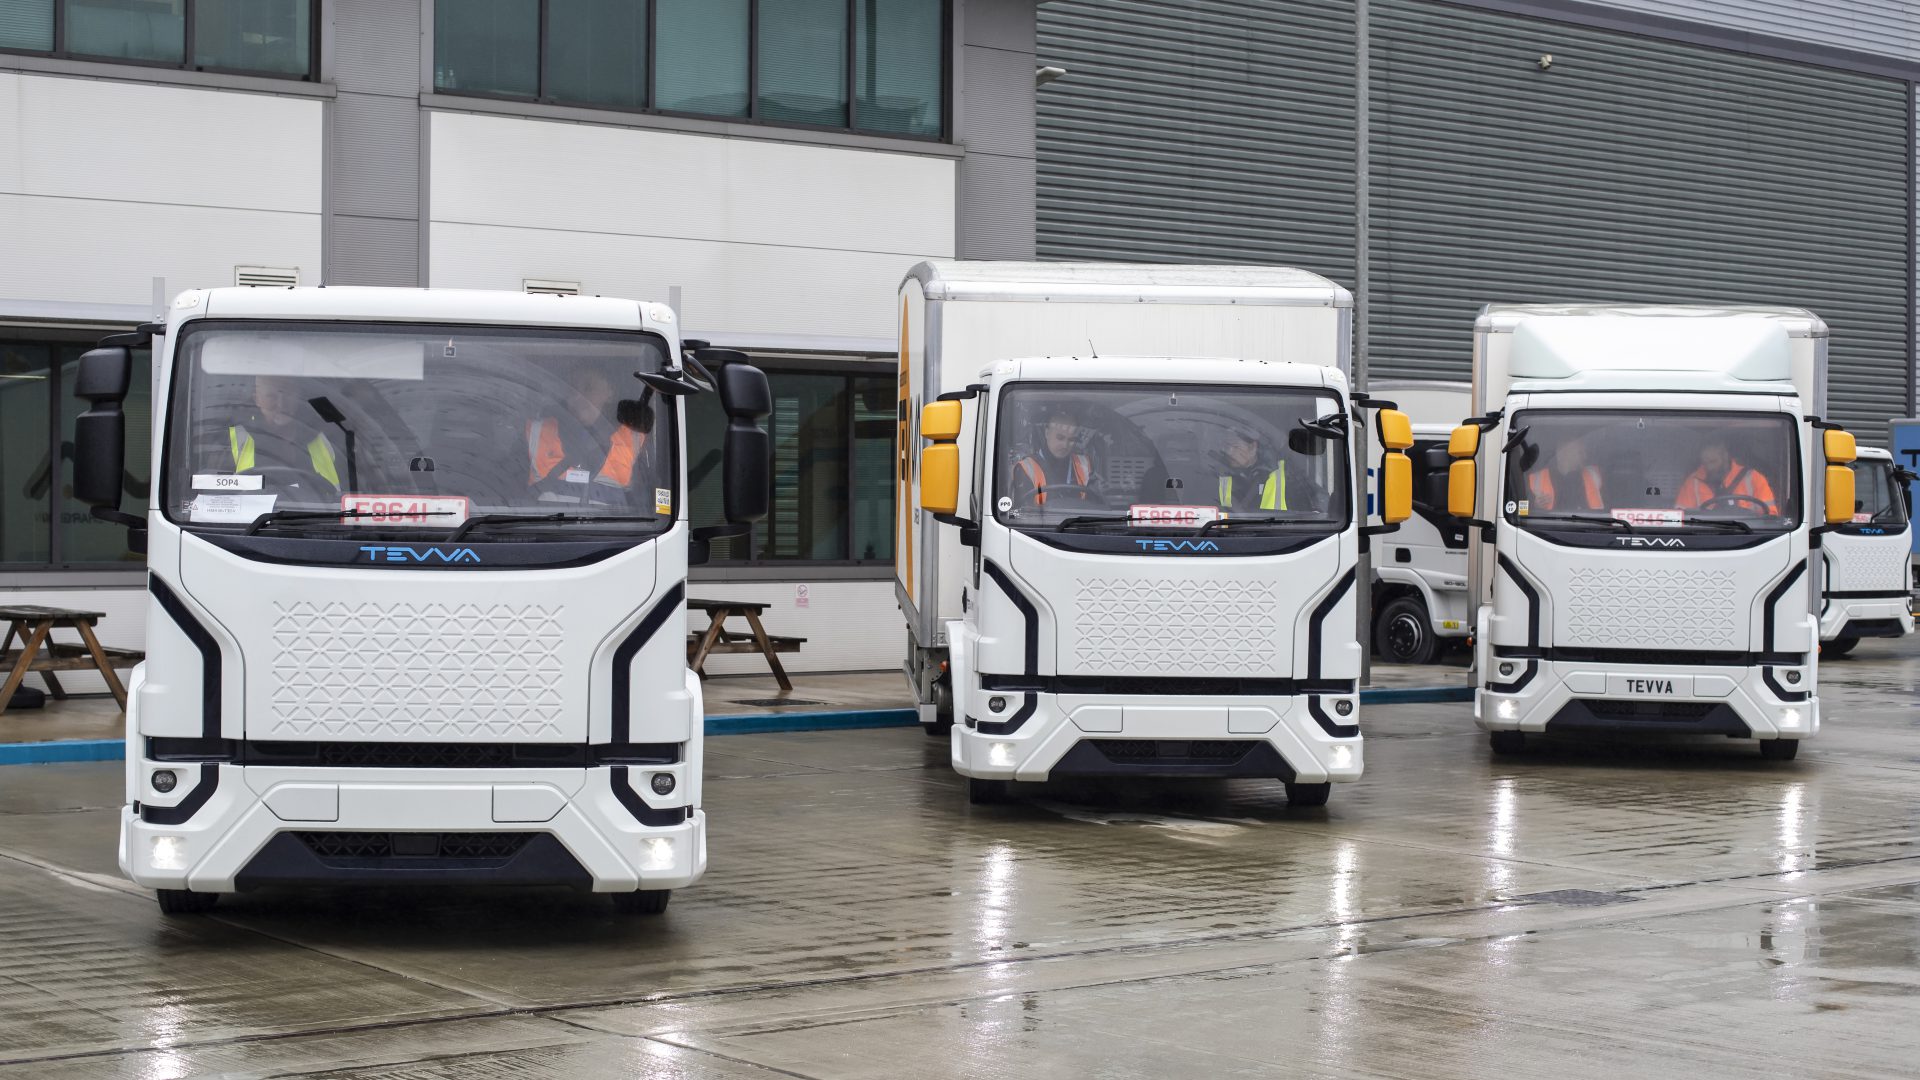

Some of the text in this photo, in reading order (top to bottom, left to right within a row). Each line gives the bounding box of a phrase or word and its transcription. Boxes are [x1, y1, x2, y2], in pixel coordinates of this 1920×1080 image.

[216, 478, 239, 487] SOP4
[1135, 539, 1219, 551] TEVVA
[1616, 536, 1685, 547] TEVVA
[360, 546, 481, 562] TEVVA
[1626, 679, 1673, 694] TEVVA
